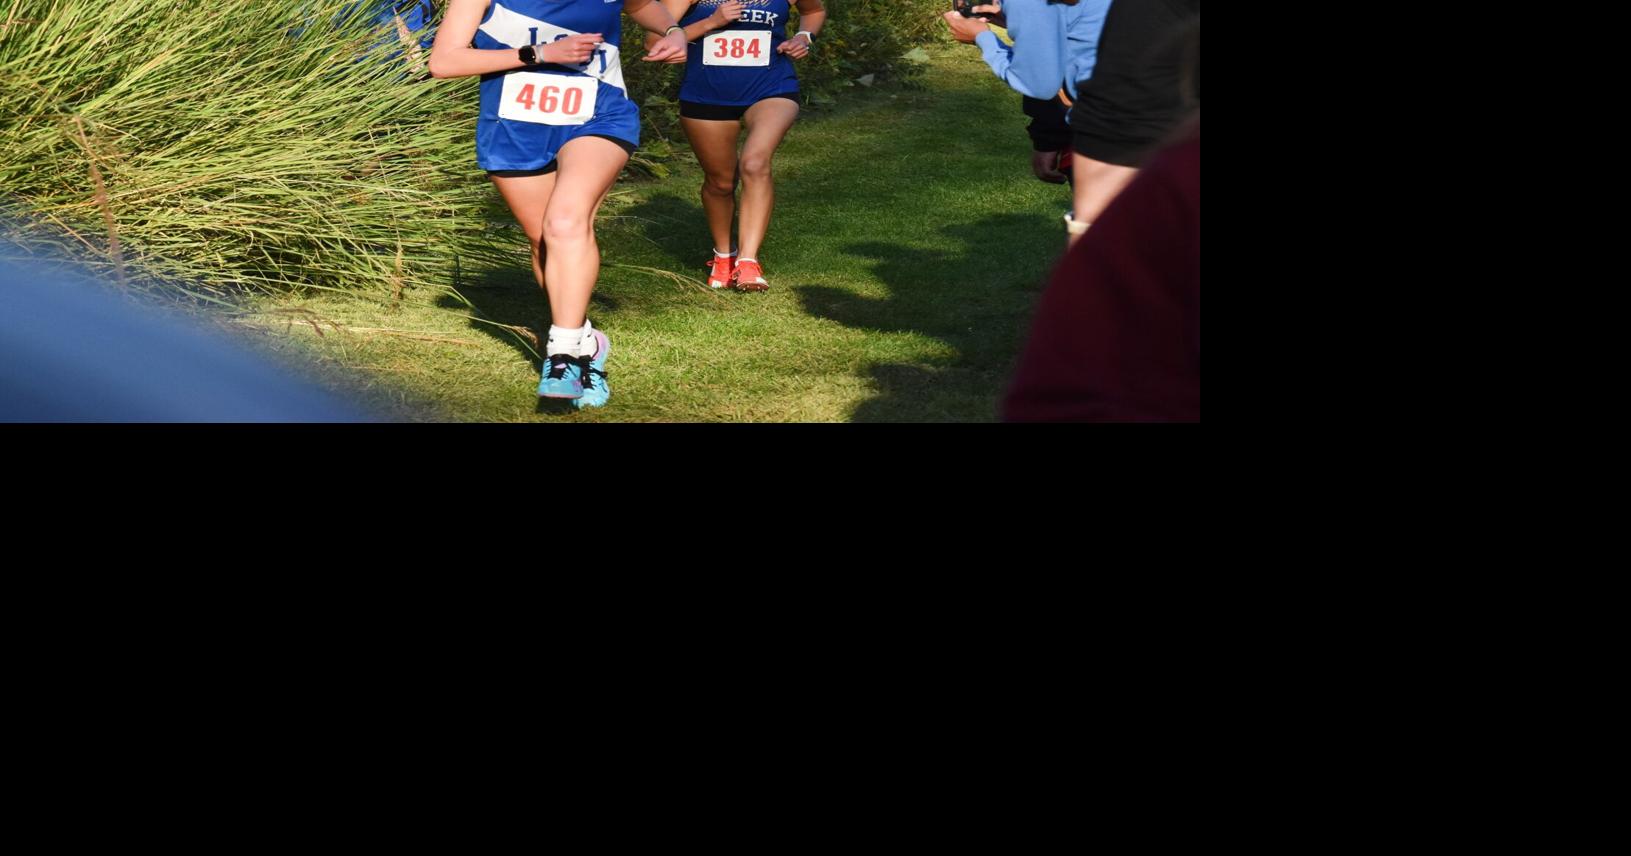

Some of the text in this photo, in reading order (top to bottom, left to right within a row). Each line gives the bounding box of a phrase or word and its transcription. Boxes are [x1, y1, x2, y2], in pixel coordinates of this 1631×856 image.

[737, 9, 779, 27] EEK
[714, 38, 761, 58] 384
[516, 83, 583, 115] 460
